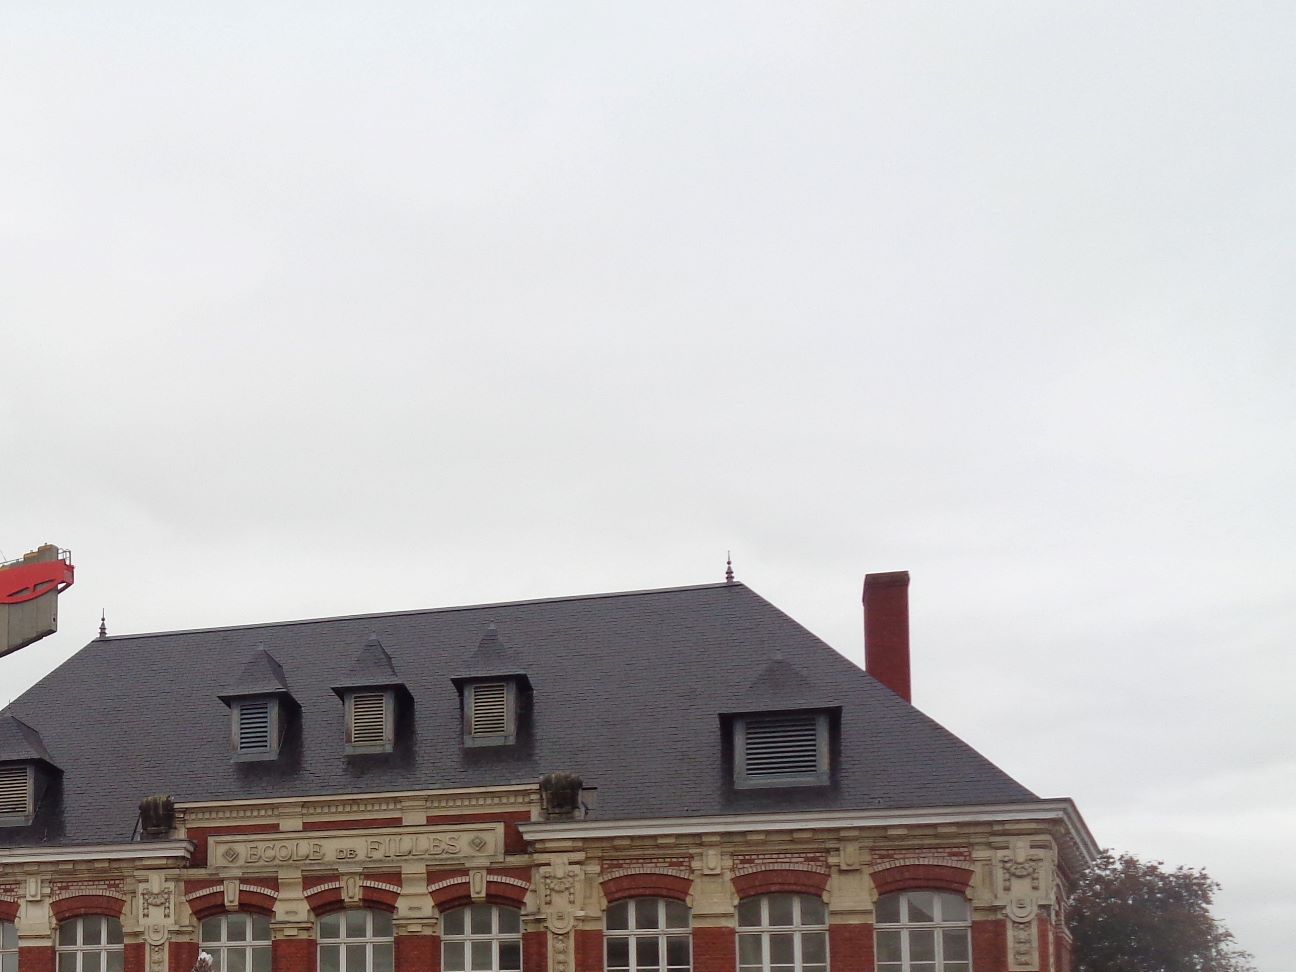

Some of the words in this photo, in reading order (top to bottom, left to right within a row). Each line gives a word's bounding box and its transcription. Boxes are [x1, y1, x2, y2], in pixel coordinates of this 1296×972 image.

[244, 841, 325, 863] ECOLE
[336, 848, 357, 860] DE
[365, 835, 461, 859] FILLES
